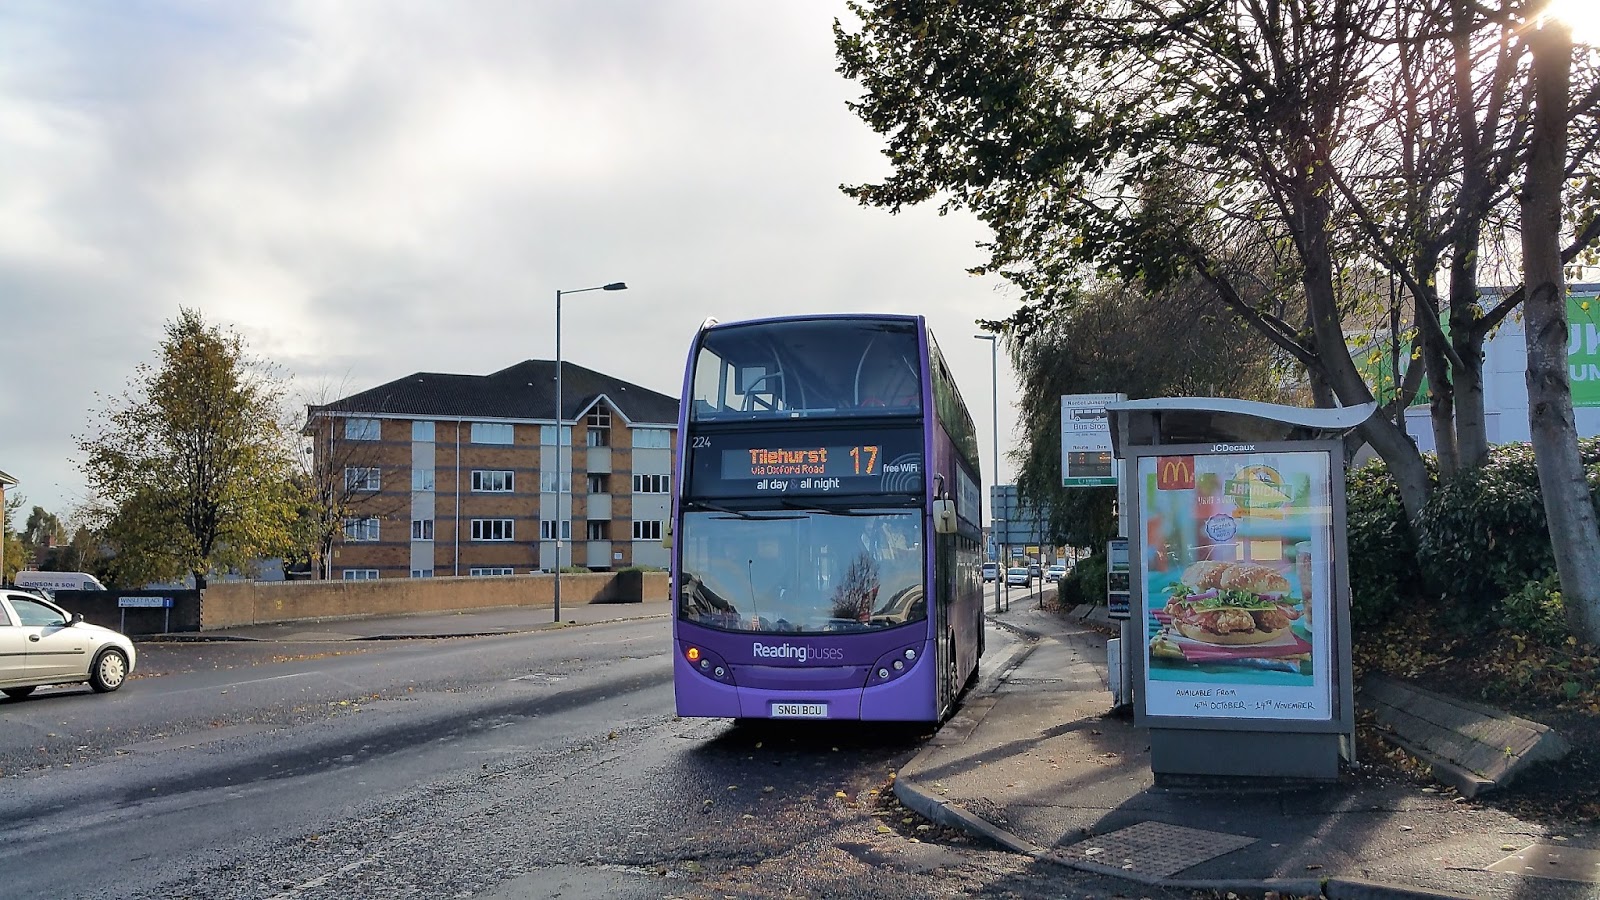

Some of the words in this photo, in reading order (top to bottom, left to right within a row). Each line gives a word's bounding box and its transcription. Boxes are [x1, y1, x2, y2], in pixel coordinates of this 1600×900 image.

[1089, 423, 1106, 431] Stop
[692, 437, 711, 448] 224
[1210, 444, 1255, 452] JCDecaux
[749, 447, 828, 464] Tilehurst
[849, 445, 878, 474] 17
[751, 465, 765, 475] via
[766, 464, 800, 475] Oxford
[801, 464, 825, 474] Road
[883, 463, 899, 472] free
[900, 463, 918, 472] WiFi
[756, 479, 768, 490] all
[770, 479, 788, 492] day
[790, 478, 798, 490] &
[800, 477, 812, 489] all
[814, 477, 840, 491] night
[1176, 688, 1212, 697] AVAILABLE
[1216, 688, 1237, 696] FROM
[778, 705, 800, 715] SN61
[802, 705, 822, 715] BCU
[1210, 700, 1247, 710] OCTOBER
[1273, 700, 1316, 710] NOVEMBER
